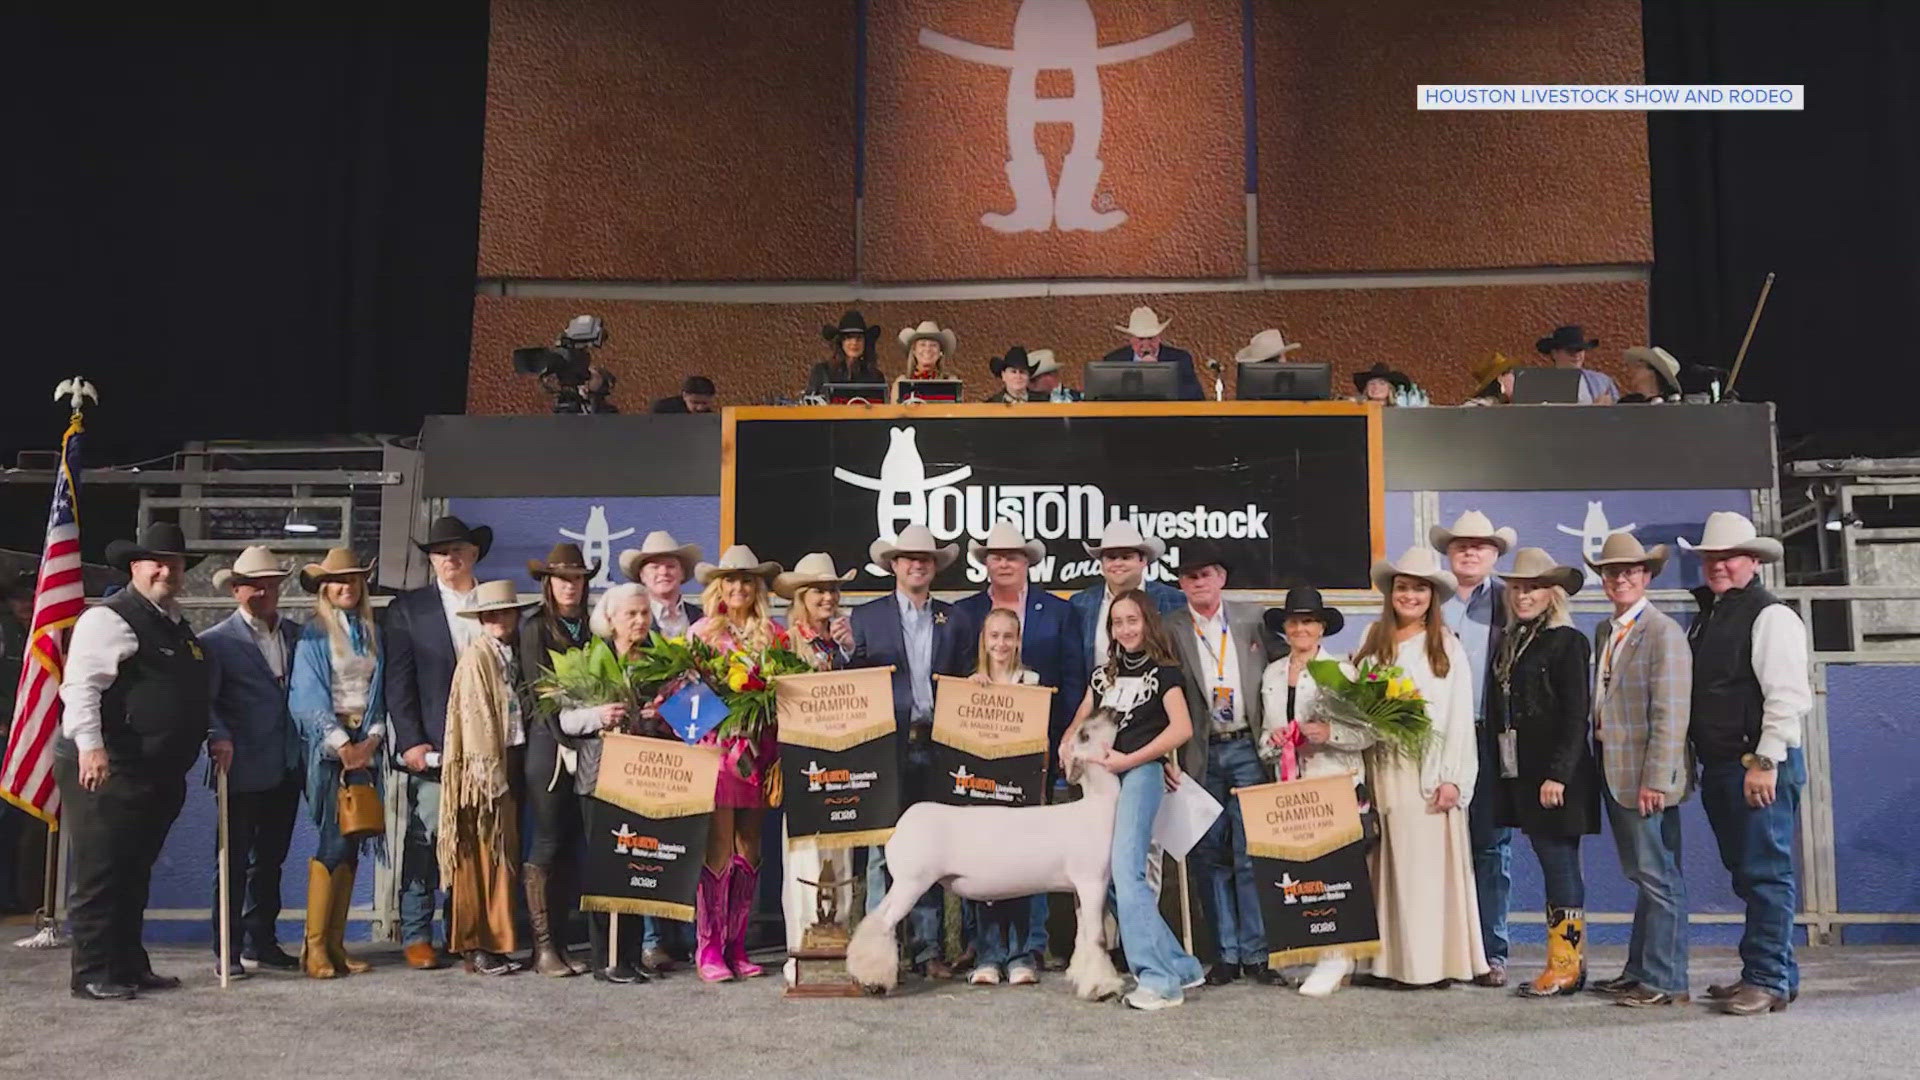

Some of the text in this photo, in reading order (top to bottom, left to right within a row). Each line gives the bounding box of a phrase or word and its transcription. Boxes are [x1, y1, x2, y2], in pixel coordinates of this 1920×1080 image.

[811, 683, 856, 698] GRAND
[690, 694, 699, 720] 1
[800, 697, 869, 714] CHAMPION
[971, 692, 1014, 709] GRAND
[958, 705, 1024, 723] CHAMPION
[638, 750, 683, 767] GRAND
[624, 763, 693, 783] CHAMPION
[1275, 791, 1320, 809] GRAND
[1266, 804, 1334, 825] CHAMPION
